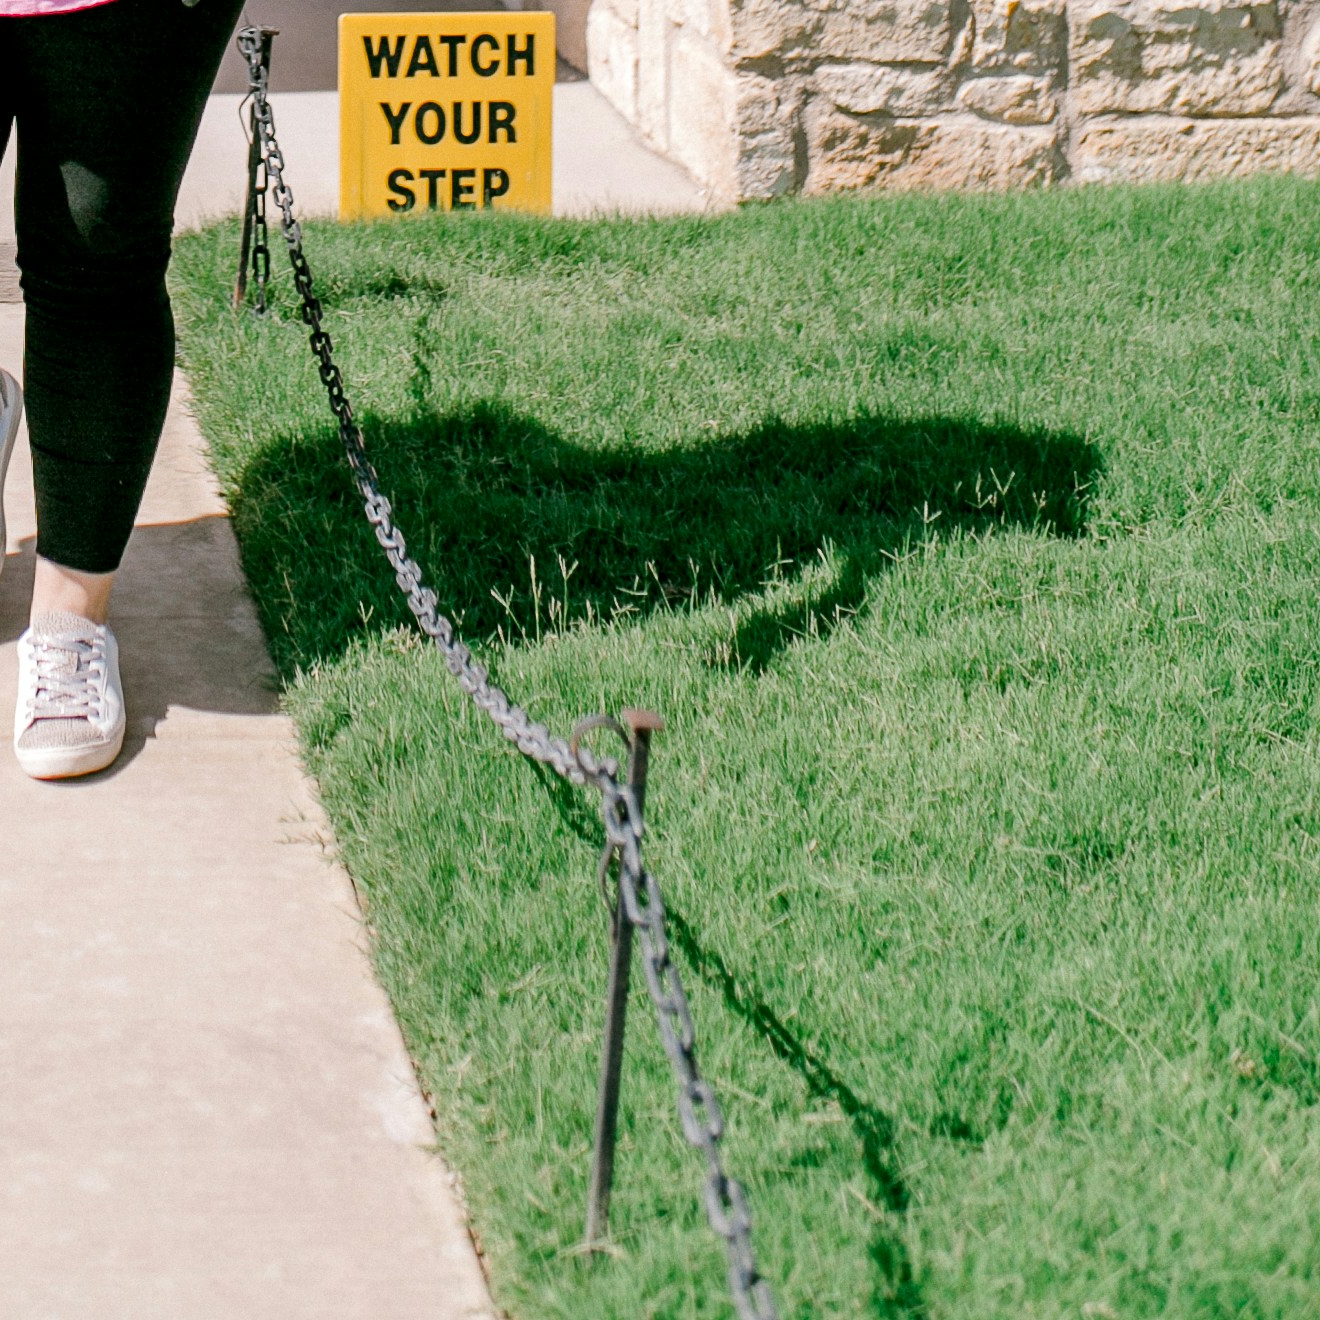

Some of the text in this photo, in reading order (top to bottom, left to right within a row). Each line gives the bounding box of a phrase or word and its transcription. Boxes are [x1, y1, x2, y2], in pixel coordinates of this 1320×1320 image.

[362, 33, 535, 78] WATCH
[380, 101, 517, 145] YOUR
[386, 168, 510, 212] STEP
